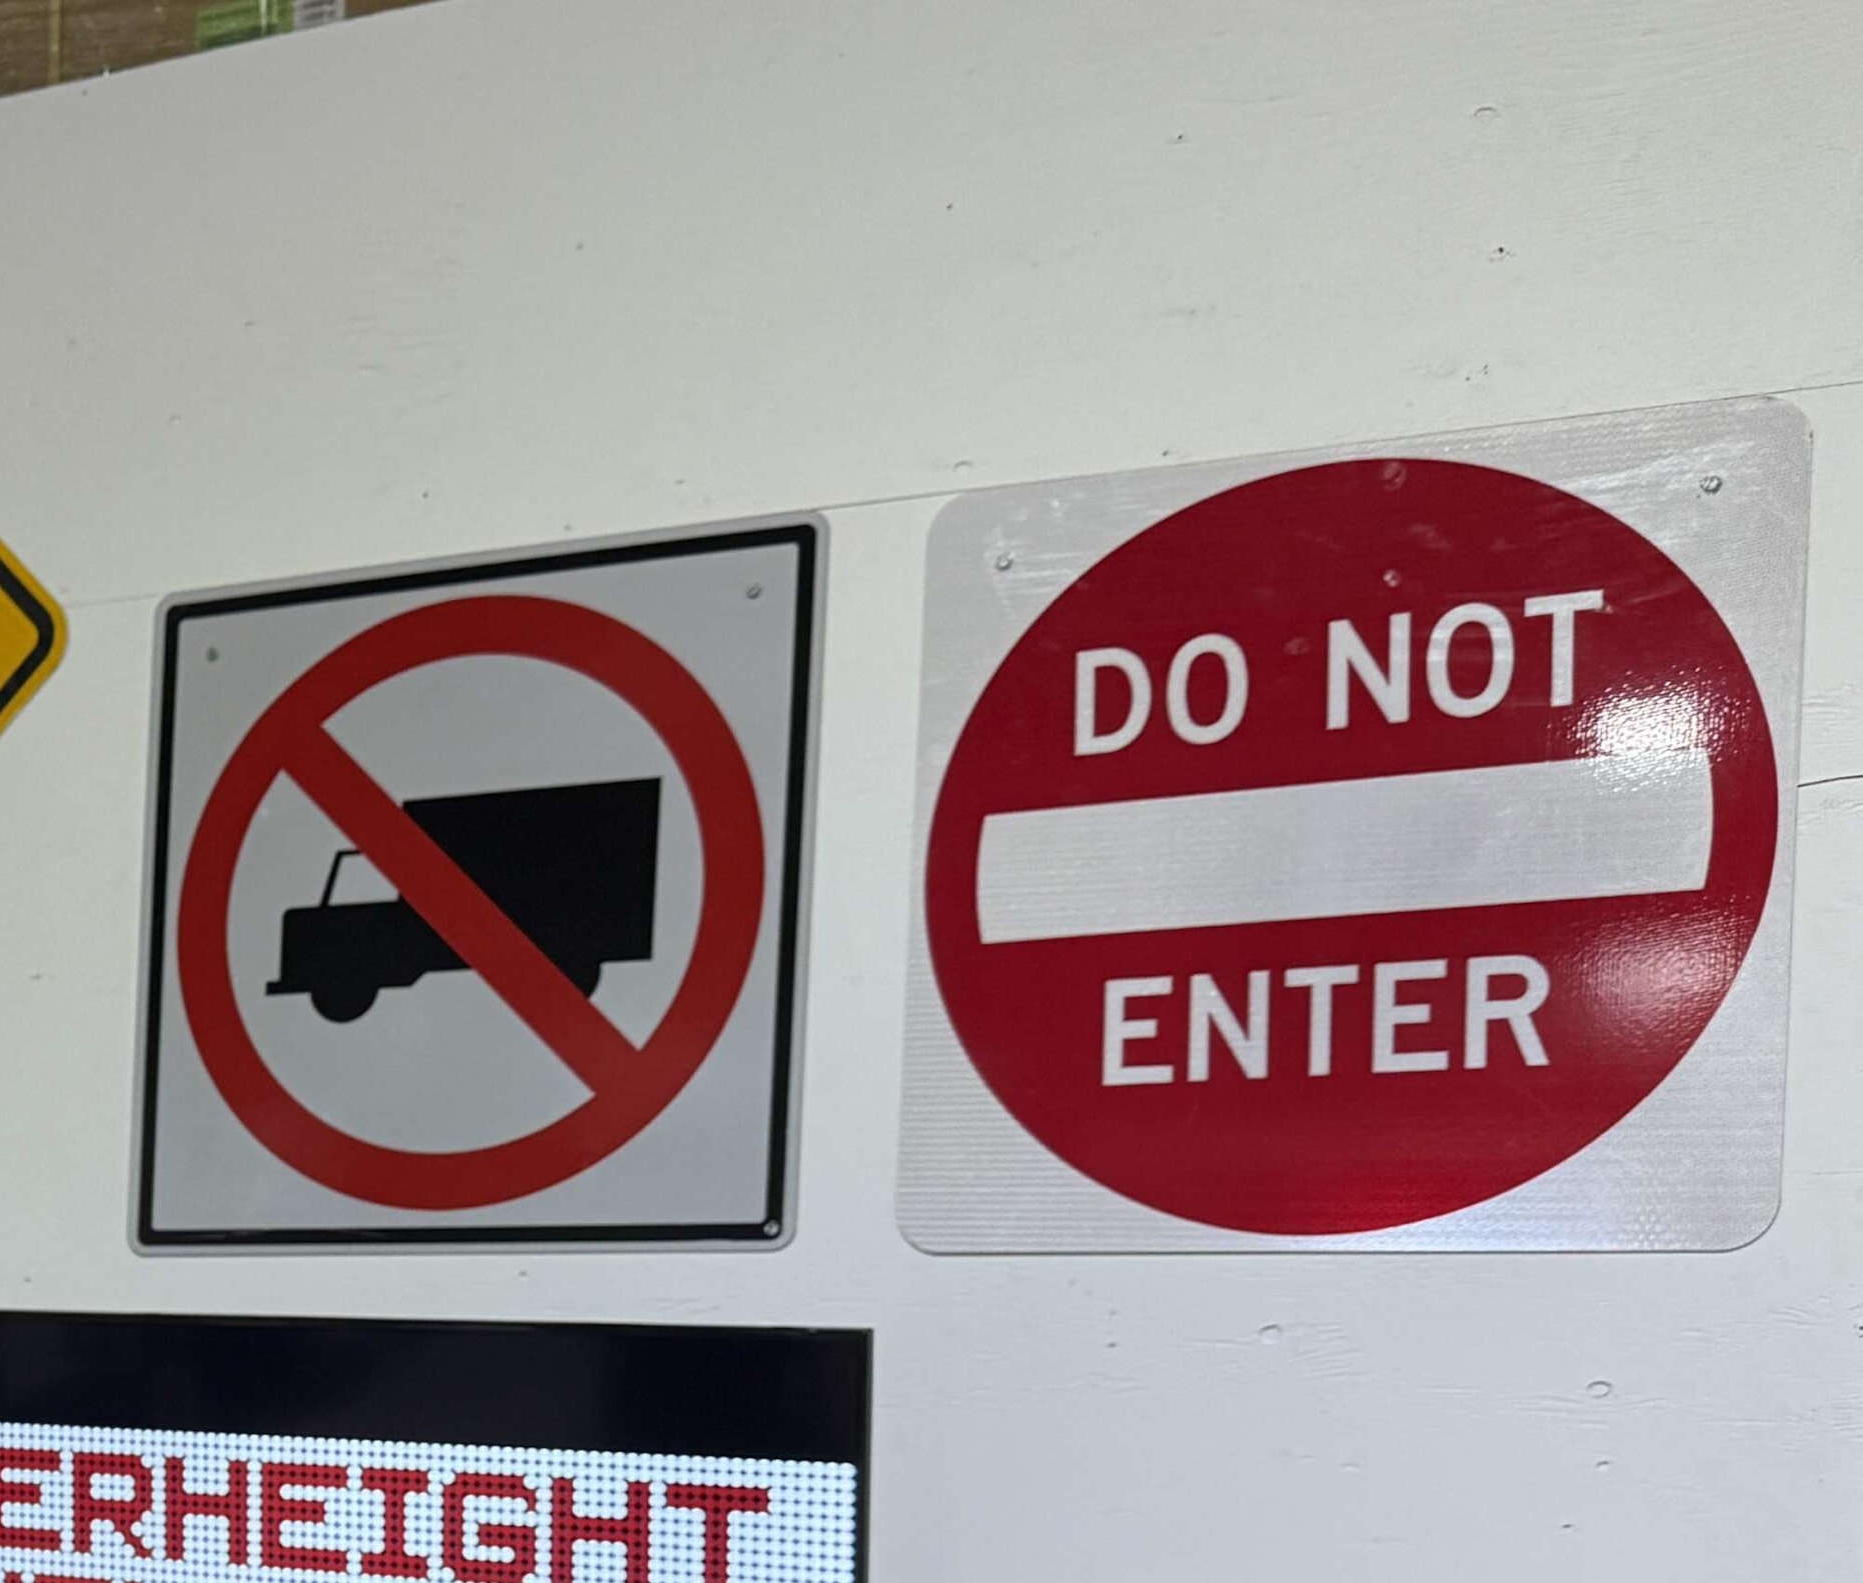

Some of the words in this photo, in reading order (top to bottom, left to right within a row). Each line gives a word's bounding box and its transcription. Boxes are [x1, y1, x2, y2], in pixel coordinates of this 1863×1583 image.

[1073, 633, 1249, 757] DO
[1326, 589, 1605, 731] NOT
[1101, 953, 1551, 1087] ENTER
